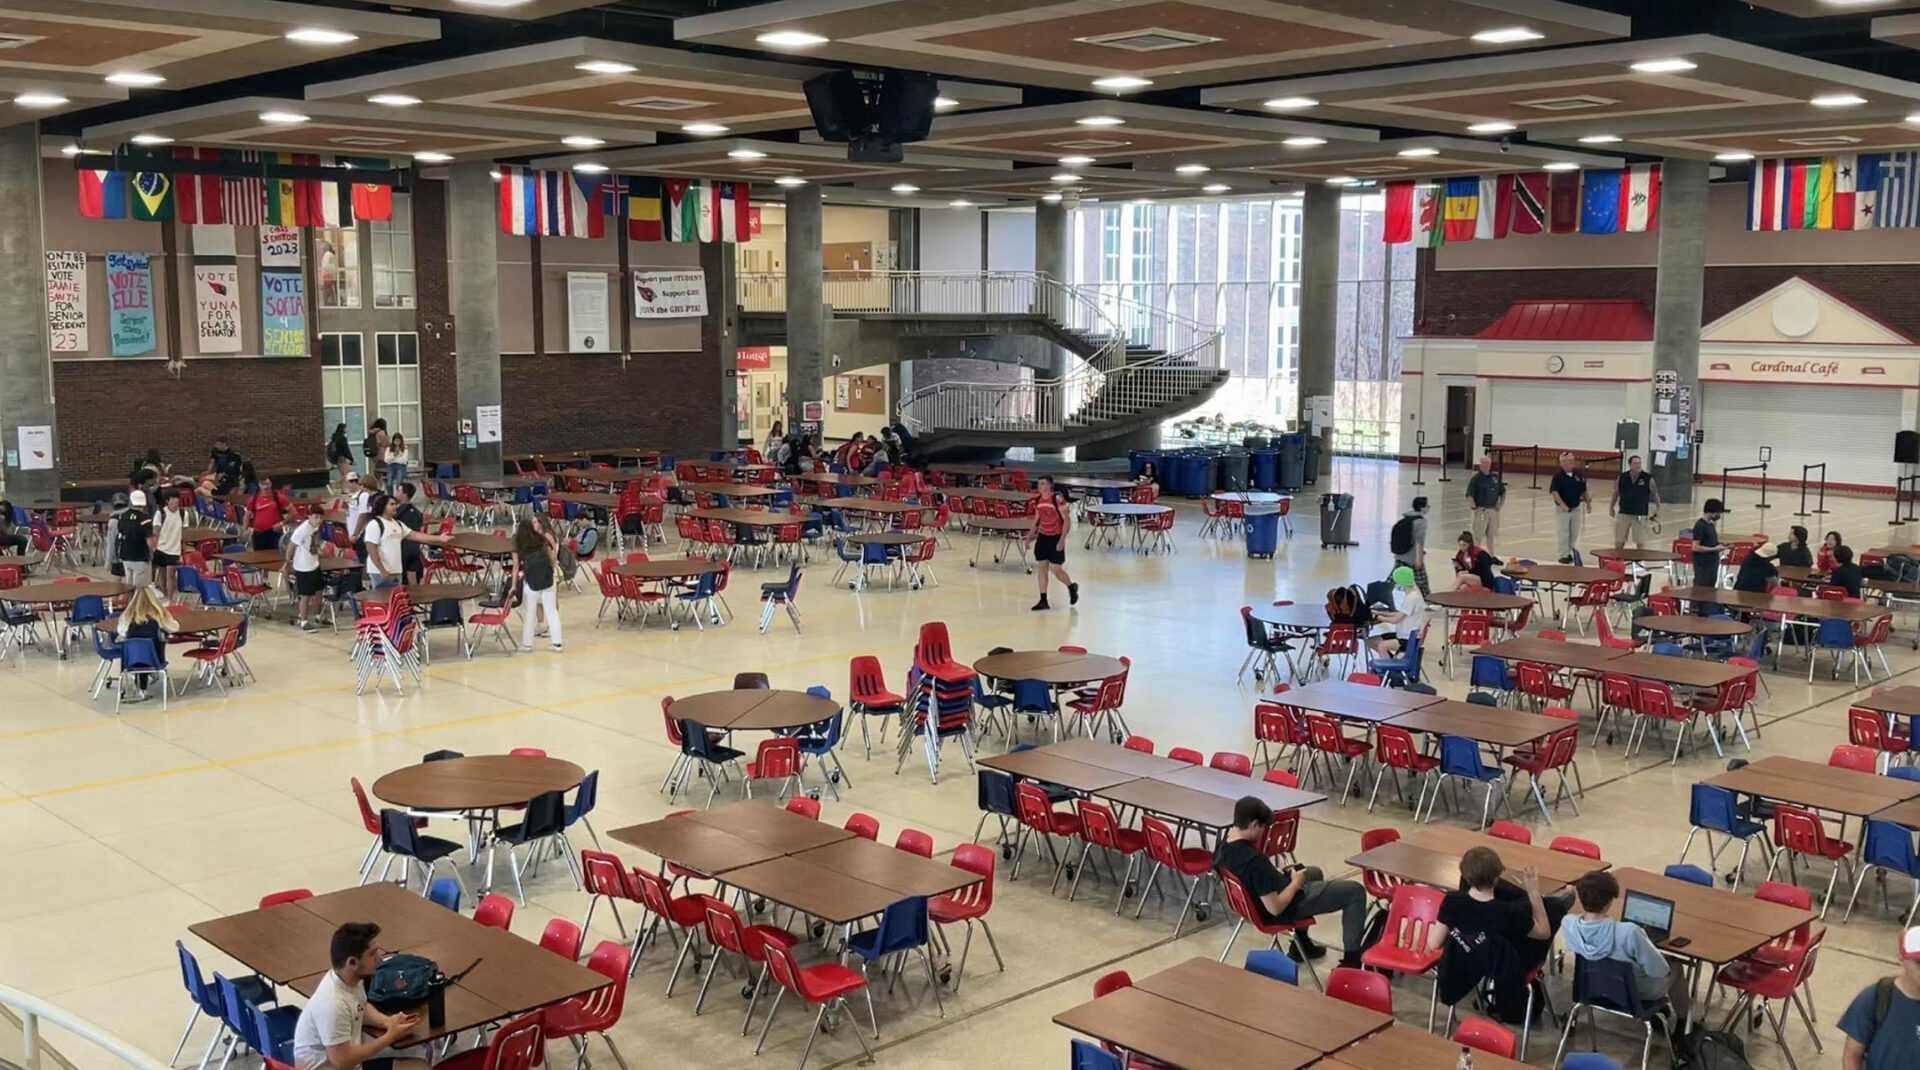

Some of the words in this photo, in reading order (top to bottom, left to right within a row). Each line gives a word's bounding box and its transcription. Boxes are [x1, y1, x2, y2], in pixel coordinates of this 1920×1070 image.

[267, 243, 298, 256] 2023
[46, 252, 72, 261] ON'T
[73, 252, 84, 262] BE
[48, 261, 85, 270] ESITANT
[51, 271, 73, 281] VOTE
[109, 272, 149, 289] VOTE
[197, 272, 236, 281] VOTE
[48, 280, 80, 293] JAMIE
[264, 275, 303, 293] VOTE
[112, 288, 148, 310] ELLE
[662, 290, 686, 298] Support
[55, 301, 74, 311] FOR
[200, 301, 238, 311] YUNA
[640, 306, 655, 315] JOIN
[656, 306, 669, 314] the
[49, 311, 84, 322] SENIOR
[208, 310, 232, 321] FOR
[201, 320, 236, 330] CLASS
[201, 328, 236, 338] SENATOR
[737, 351, 767, 363] House
[1751, 361, 1809, 373] Cardinal
[1810, 362, 1839, 377] Café
